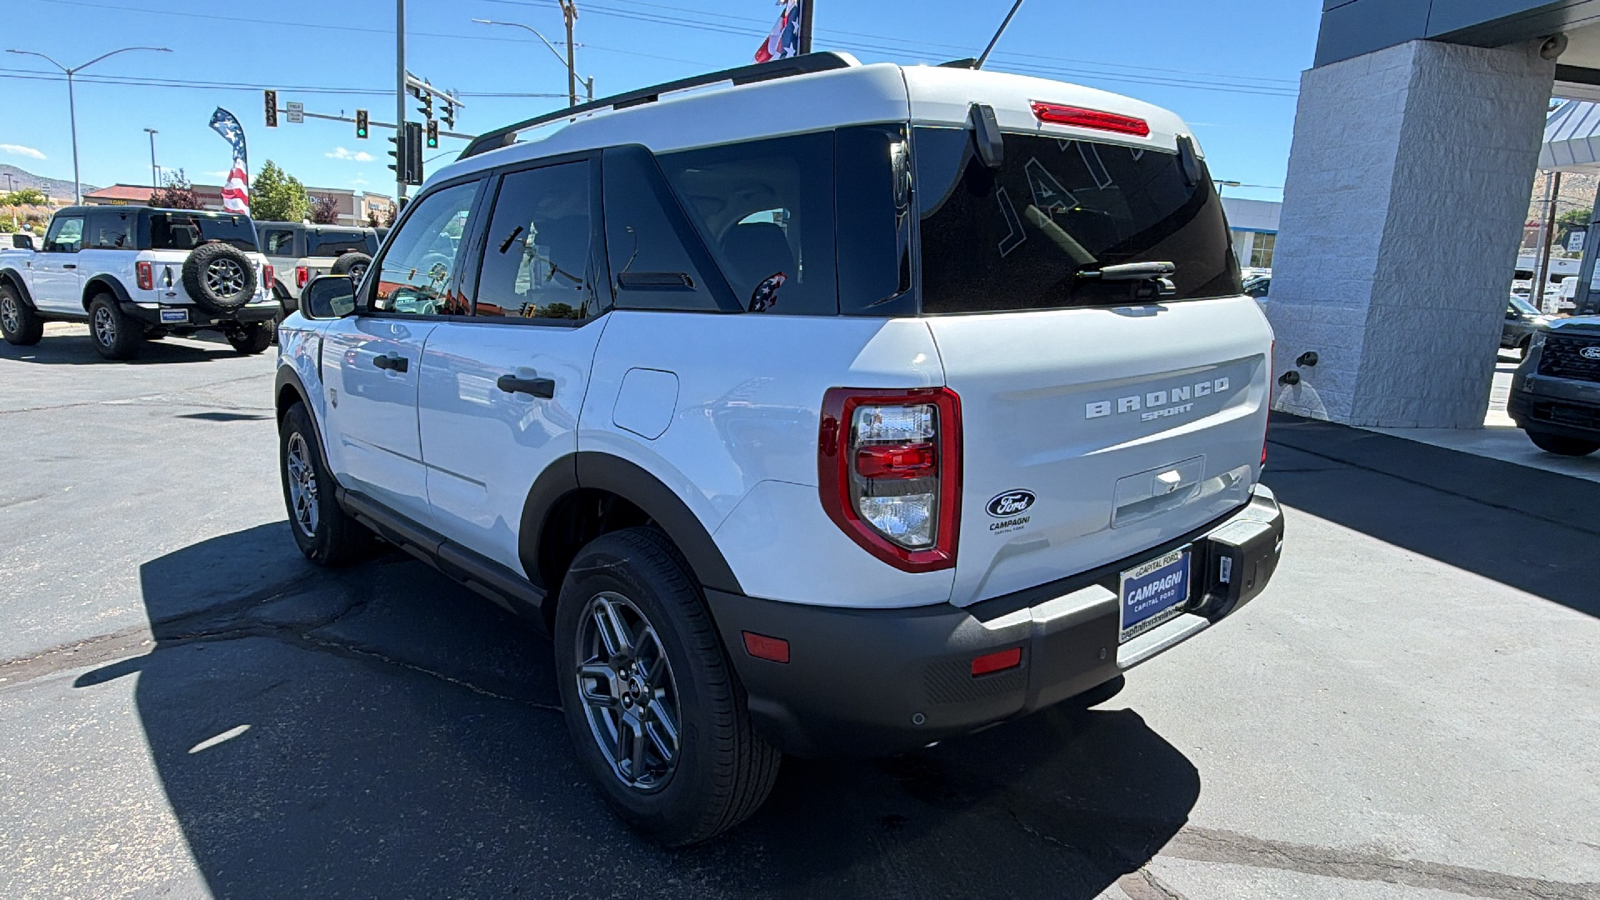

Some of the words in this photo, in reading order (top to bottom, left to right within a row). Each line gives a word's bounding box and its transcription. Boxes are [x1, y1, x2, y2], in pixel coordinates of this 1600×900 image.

[1085, 376, 1229, 419] BRONCO
[1140, 402, 1194, 422] SPORT
[996, 494, 1029, 514] Ford
[989, 516, 1030, 531] CAMPAGNI
[1127, 570, 1183, 606] CAMPAGNI
[1134, 597, 1159, 612] CAPITAL
[1159, 589, 1175, 602] FORD
